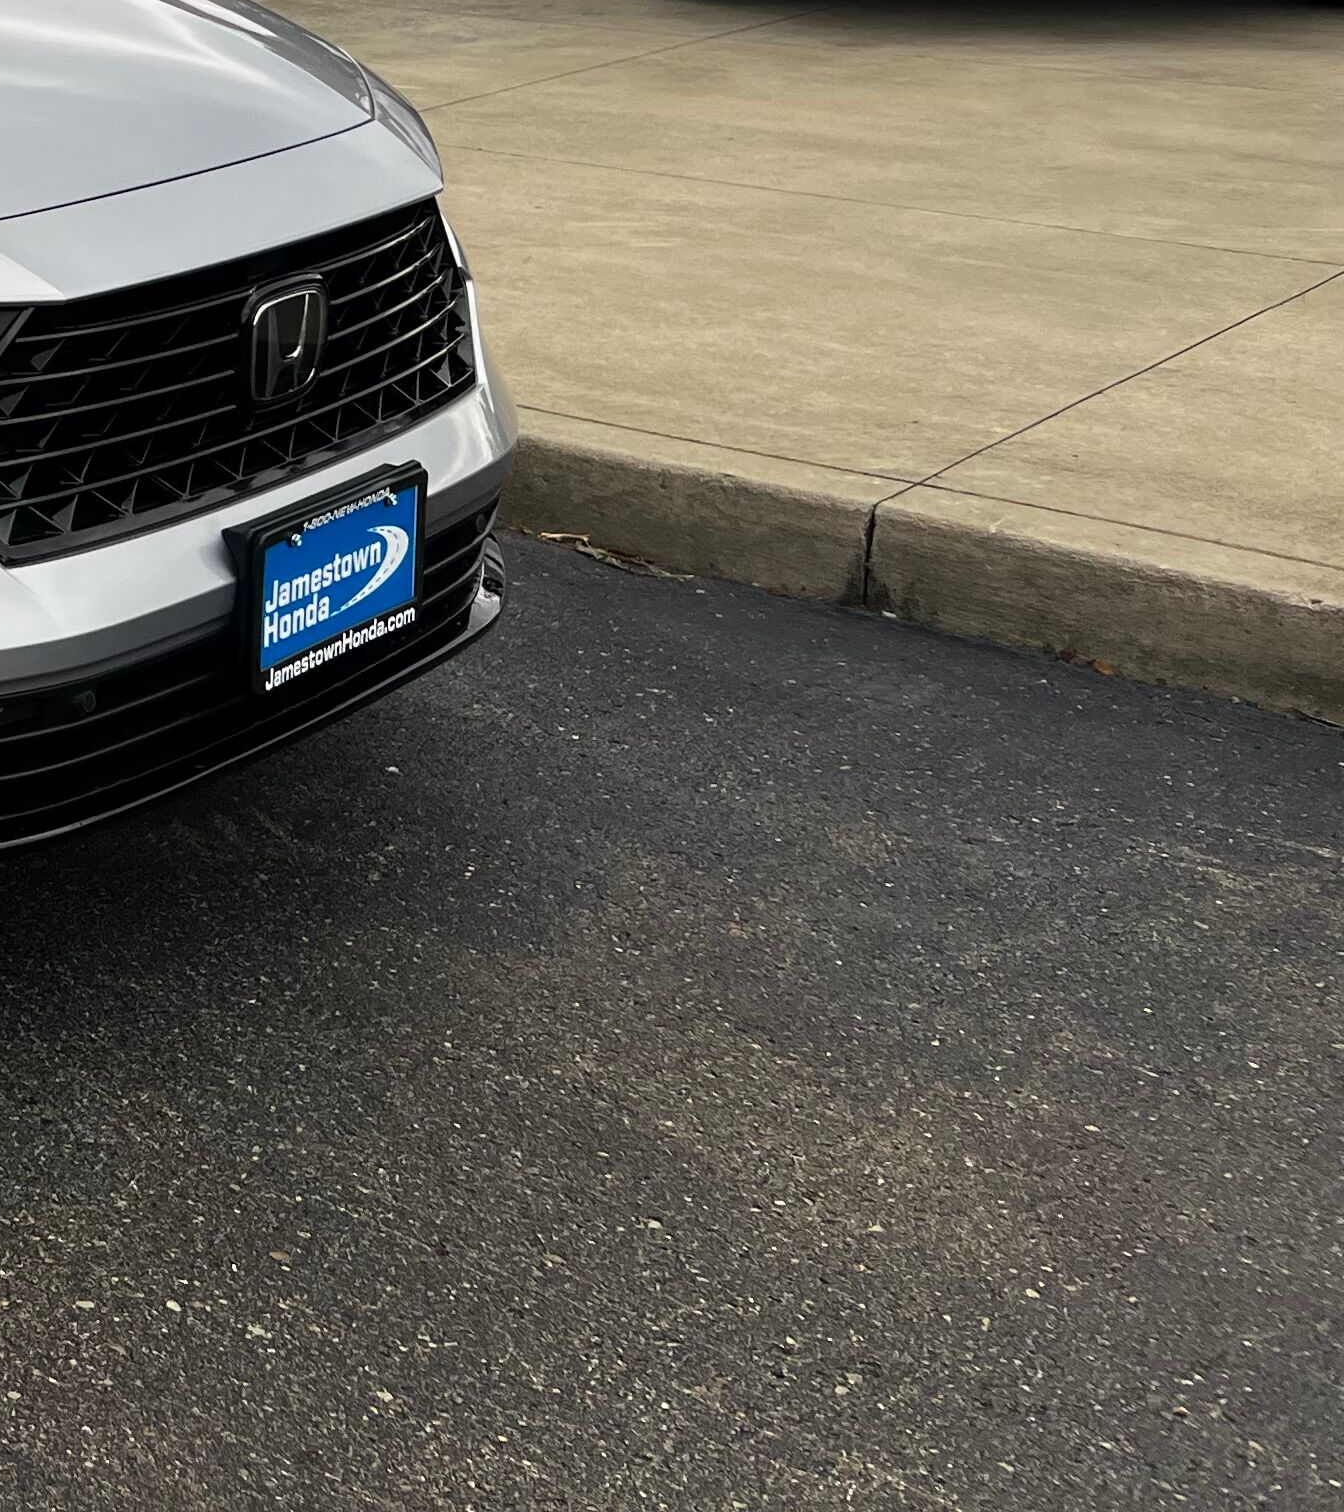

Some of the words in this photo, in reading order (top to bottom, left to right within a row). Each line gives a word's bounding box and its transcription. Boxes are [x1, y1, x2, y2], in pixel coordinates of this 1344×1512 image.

[265, 540, 382, 613] Jamestown
[263, 593, 331, 648] Honda
[265, 607, 416, 691] JamestownHonda.com
